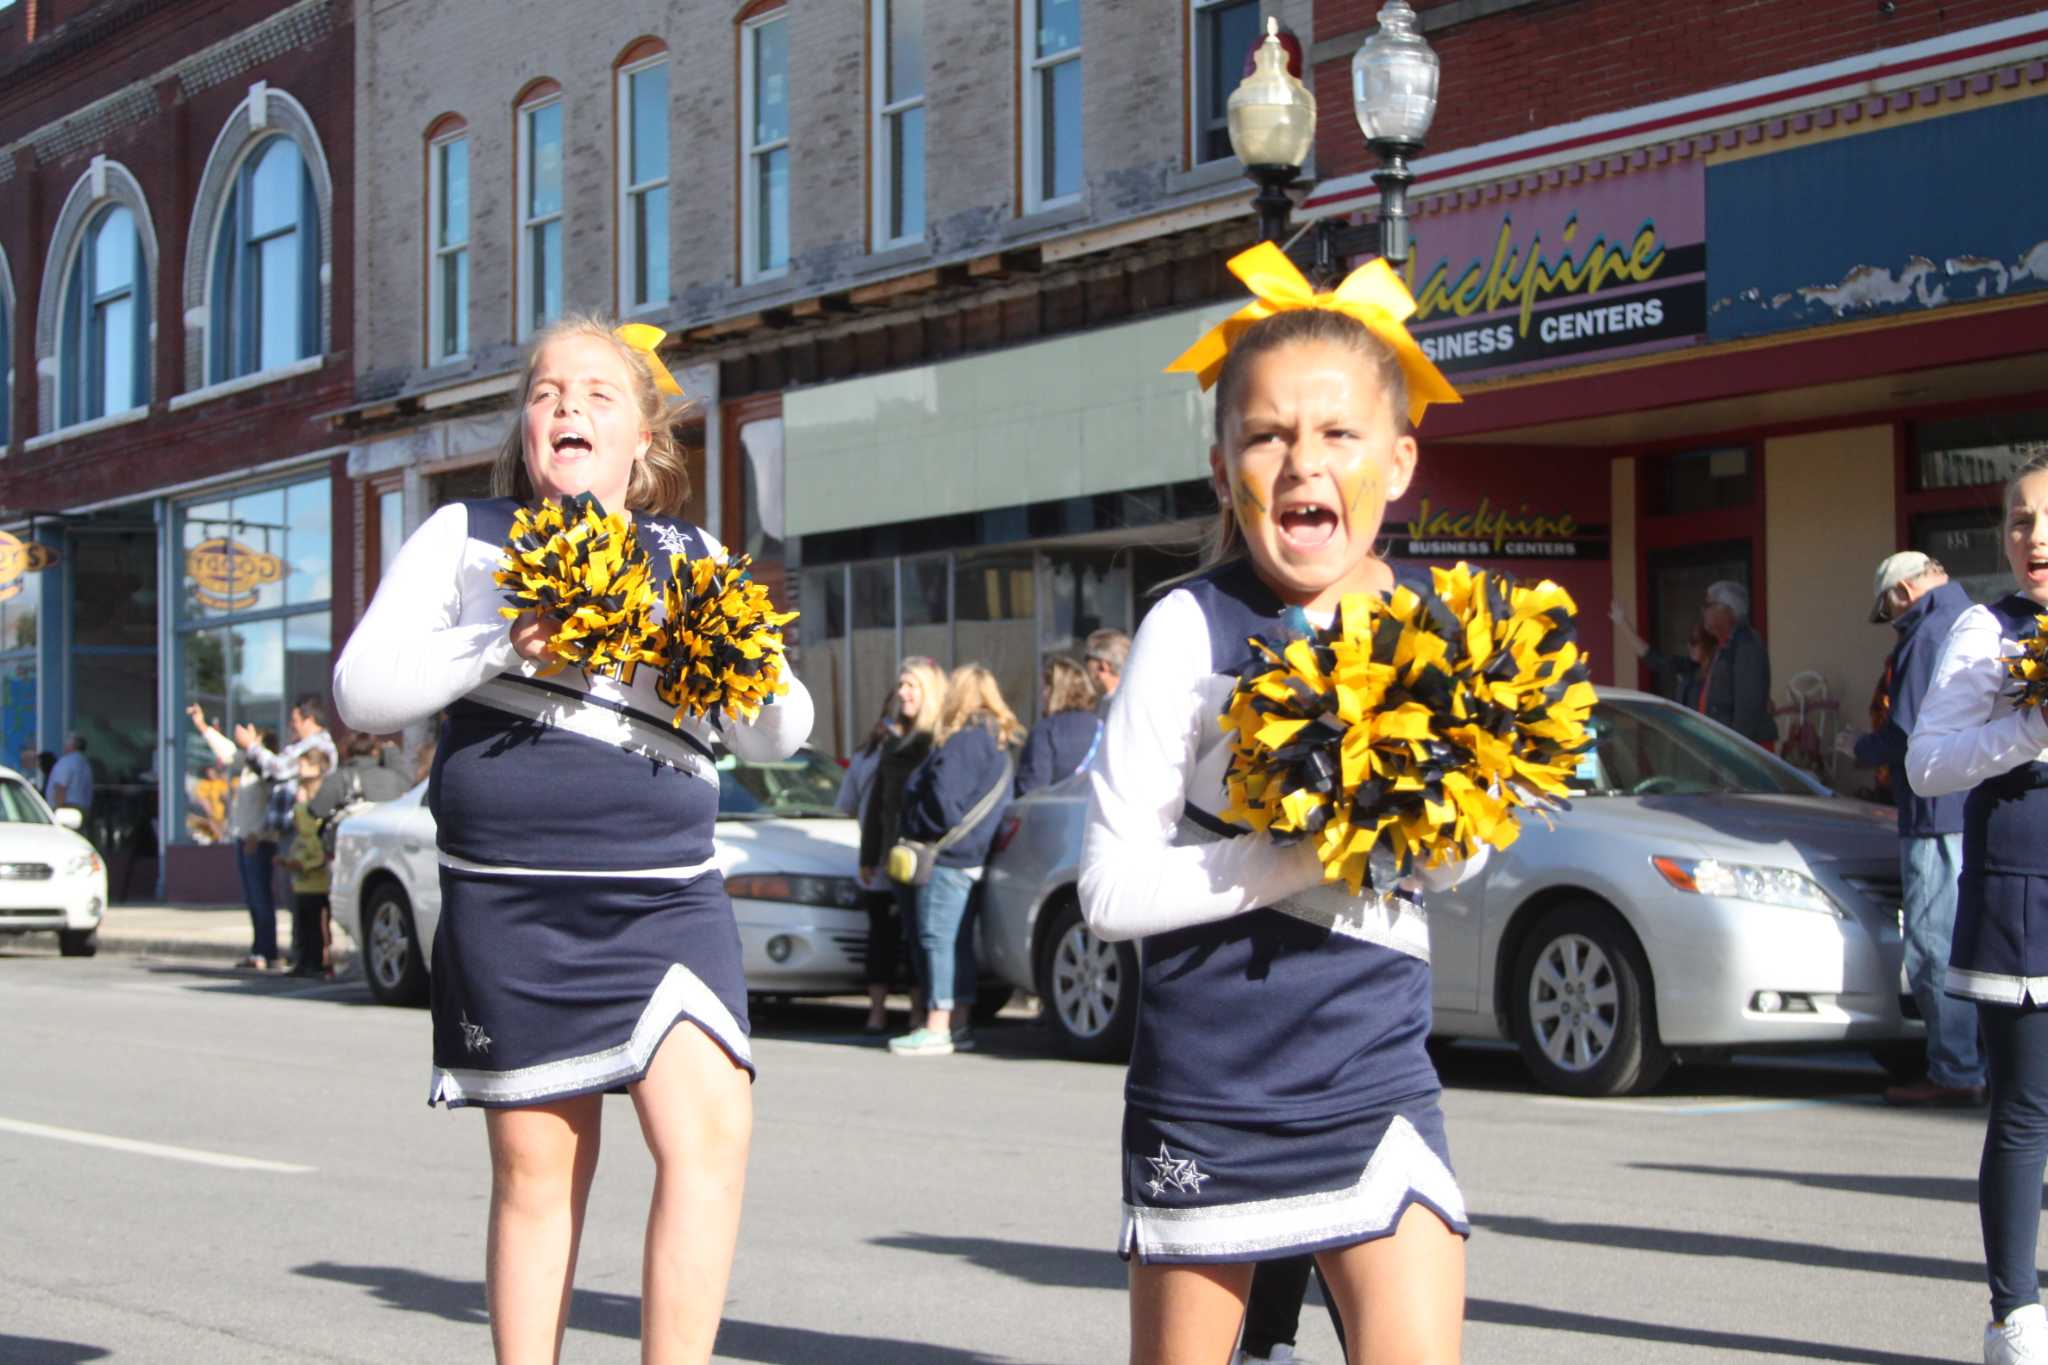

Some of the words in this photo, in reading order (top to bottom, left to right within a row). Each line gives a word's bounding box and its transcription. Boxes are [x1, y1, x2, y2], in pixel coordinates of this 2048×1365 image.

[1421, 325, 1515, 361] SINESS
[1540, 299, 1664, 343] CENTERS
[1408, 493, 1576, 549] Jackpine
[1408, 540, 1490, 555] BUSINESS
[1505, 542, 1576, 556] CENTERS
